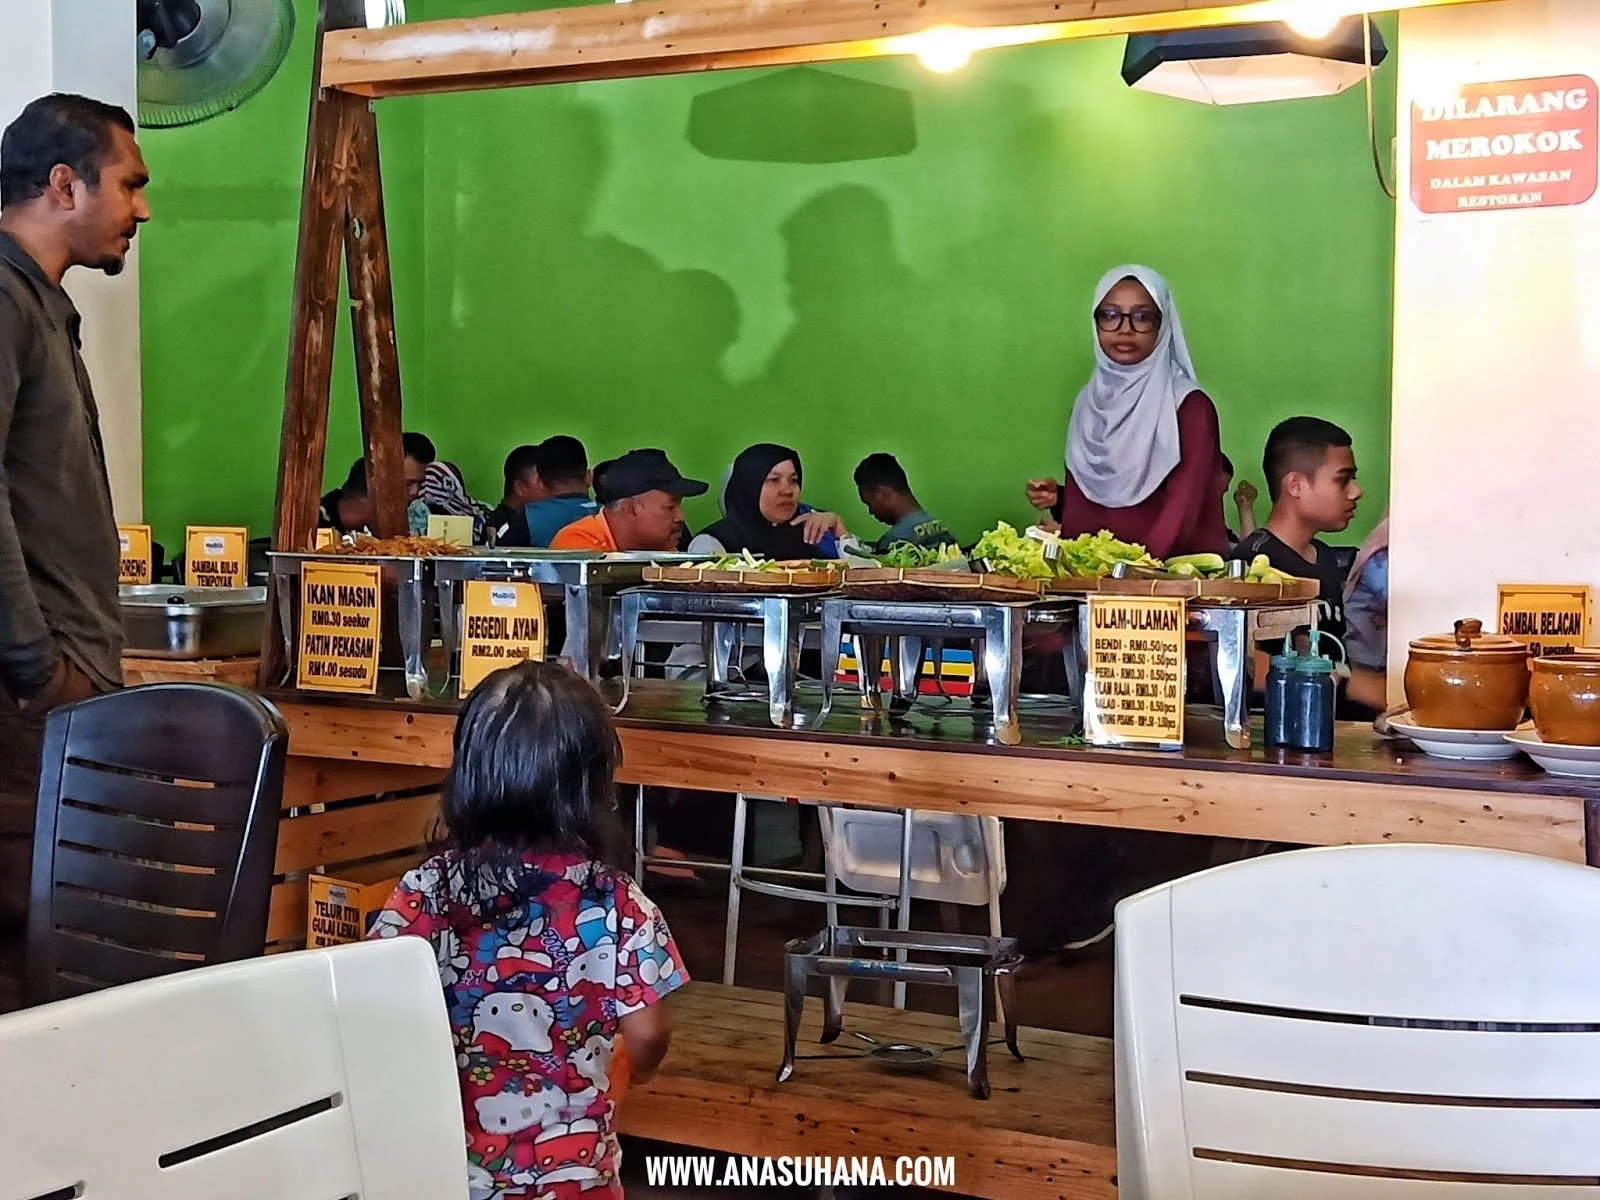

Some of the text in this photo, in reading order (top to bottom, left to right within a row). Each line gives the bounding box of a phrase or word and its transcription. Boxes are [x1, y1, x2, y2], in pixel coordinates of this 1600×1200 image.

[1421, 88, 1588, 122] DILARANG
[1425, 128, 1583, 160] MEROKOK
[1429, 169, 1572, 190] DALAM KAWASAN
[1457, 192, 1543, 208] RESTORAN
[120, 559, 147, 577] ORENG
[192, 560, 239, 574] SAMBAL BILIS
[197, 575, 233, 587] TEMPOYAK
[307, 584, 376, 608] IKAN MASIN
[312, 610, 371, 628] RM0.30 seekor
[1095, 608, 1178, 631] ULAM-ULAMAN
[1503, 612, 1581, 635] SAMBAL BELACAN
[468, 616, 538, 642] BEGEDIL AYAM
[305, 634, 374, 659] PATIN PEKASAM
[472, 644, 505, 658] RM2.00
[1095, 638, 1121, 651] BENDI
[1129, 639, 1178, 655] RM0.50/pcs
[1095, 652, 1117, 664] TIMUN
[1122, 653, 1146, 665] RM0.50
[308, 661, 367, 679] RM1.00 sesudu
[1095, 667, 1115, 679] PERIA
[1120, 668, 1145, 680] RM0.30
[1114, 683, 1131, 697] RAJA
[1136, 684, 1158, 698] RM0.30
[1163, 684, 1176, 699] 1.00
[315, 900, 342, 920] TELUR
[313, 917, 358, 939] GULAI LEMA
